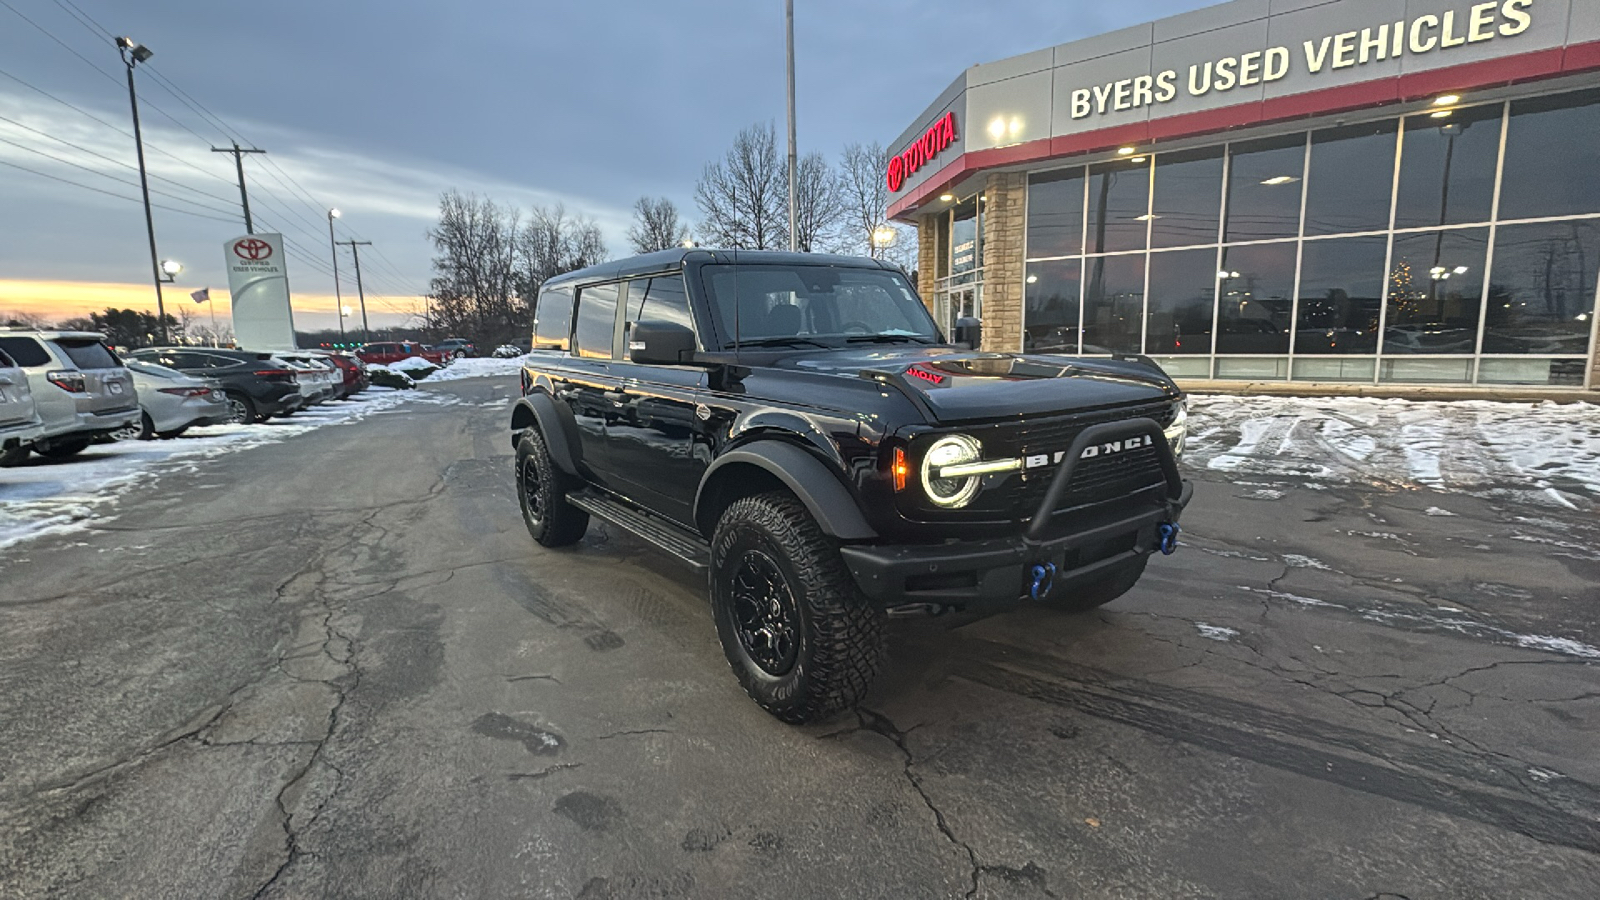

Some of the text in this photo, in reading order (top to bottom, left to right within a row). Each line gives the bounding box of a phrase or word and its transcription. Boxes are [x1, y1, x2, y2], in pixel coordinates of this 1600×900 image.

[1071, 0, 1533, 119] BYERS USED VEHICLES
[902, 111, 954, 178] TOYOTA
